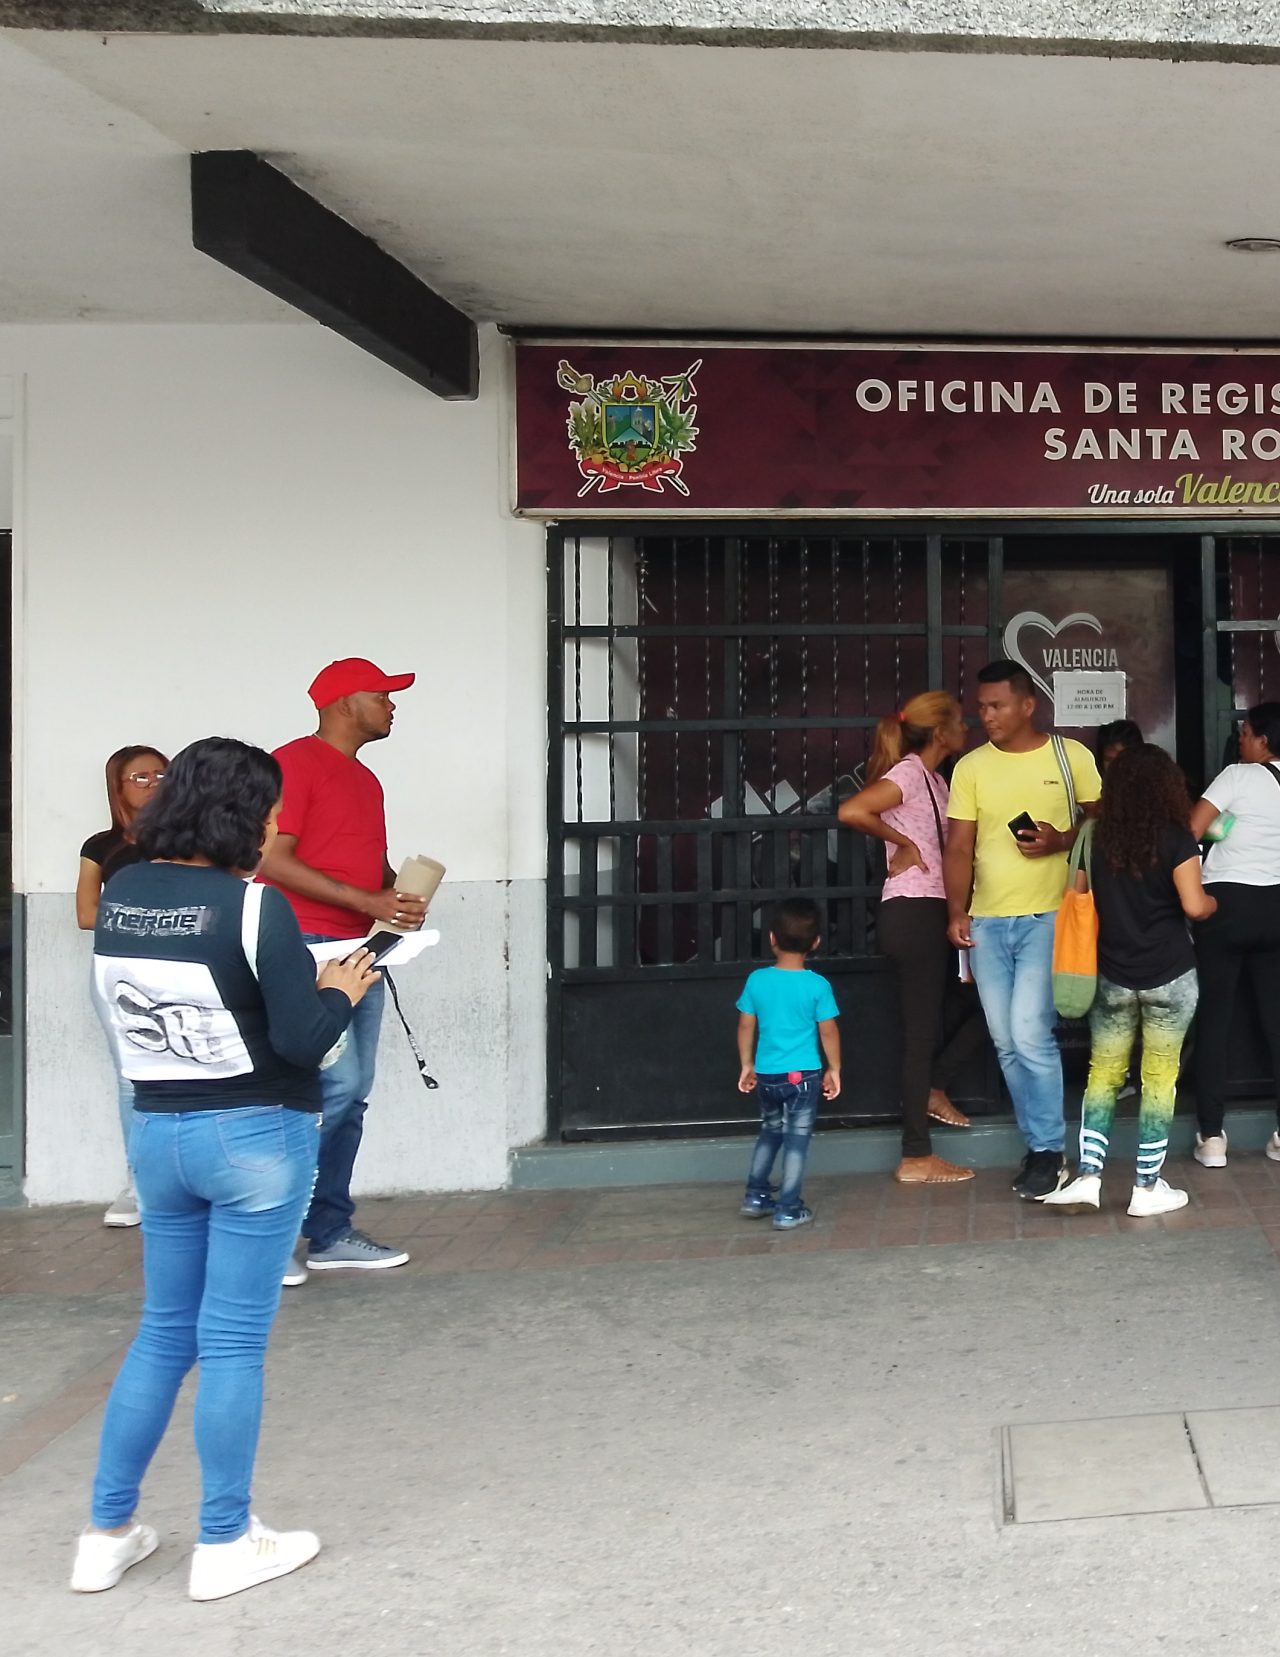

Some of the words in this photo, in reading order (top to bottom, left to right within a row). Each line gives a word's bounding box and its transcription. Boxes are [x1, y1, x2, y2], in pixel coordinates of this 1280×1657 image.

[855, 378, 1061, 413] OFICINA
[1084, 382, 1137, 414] DE
[1043, 427, 1200, 461] SANTA
[1087, 483, 1130, 504] Una
[1132, 485, 1175, 504] sola
[1042, 648, 1119, 668] VALENCIA
